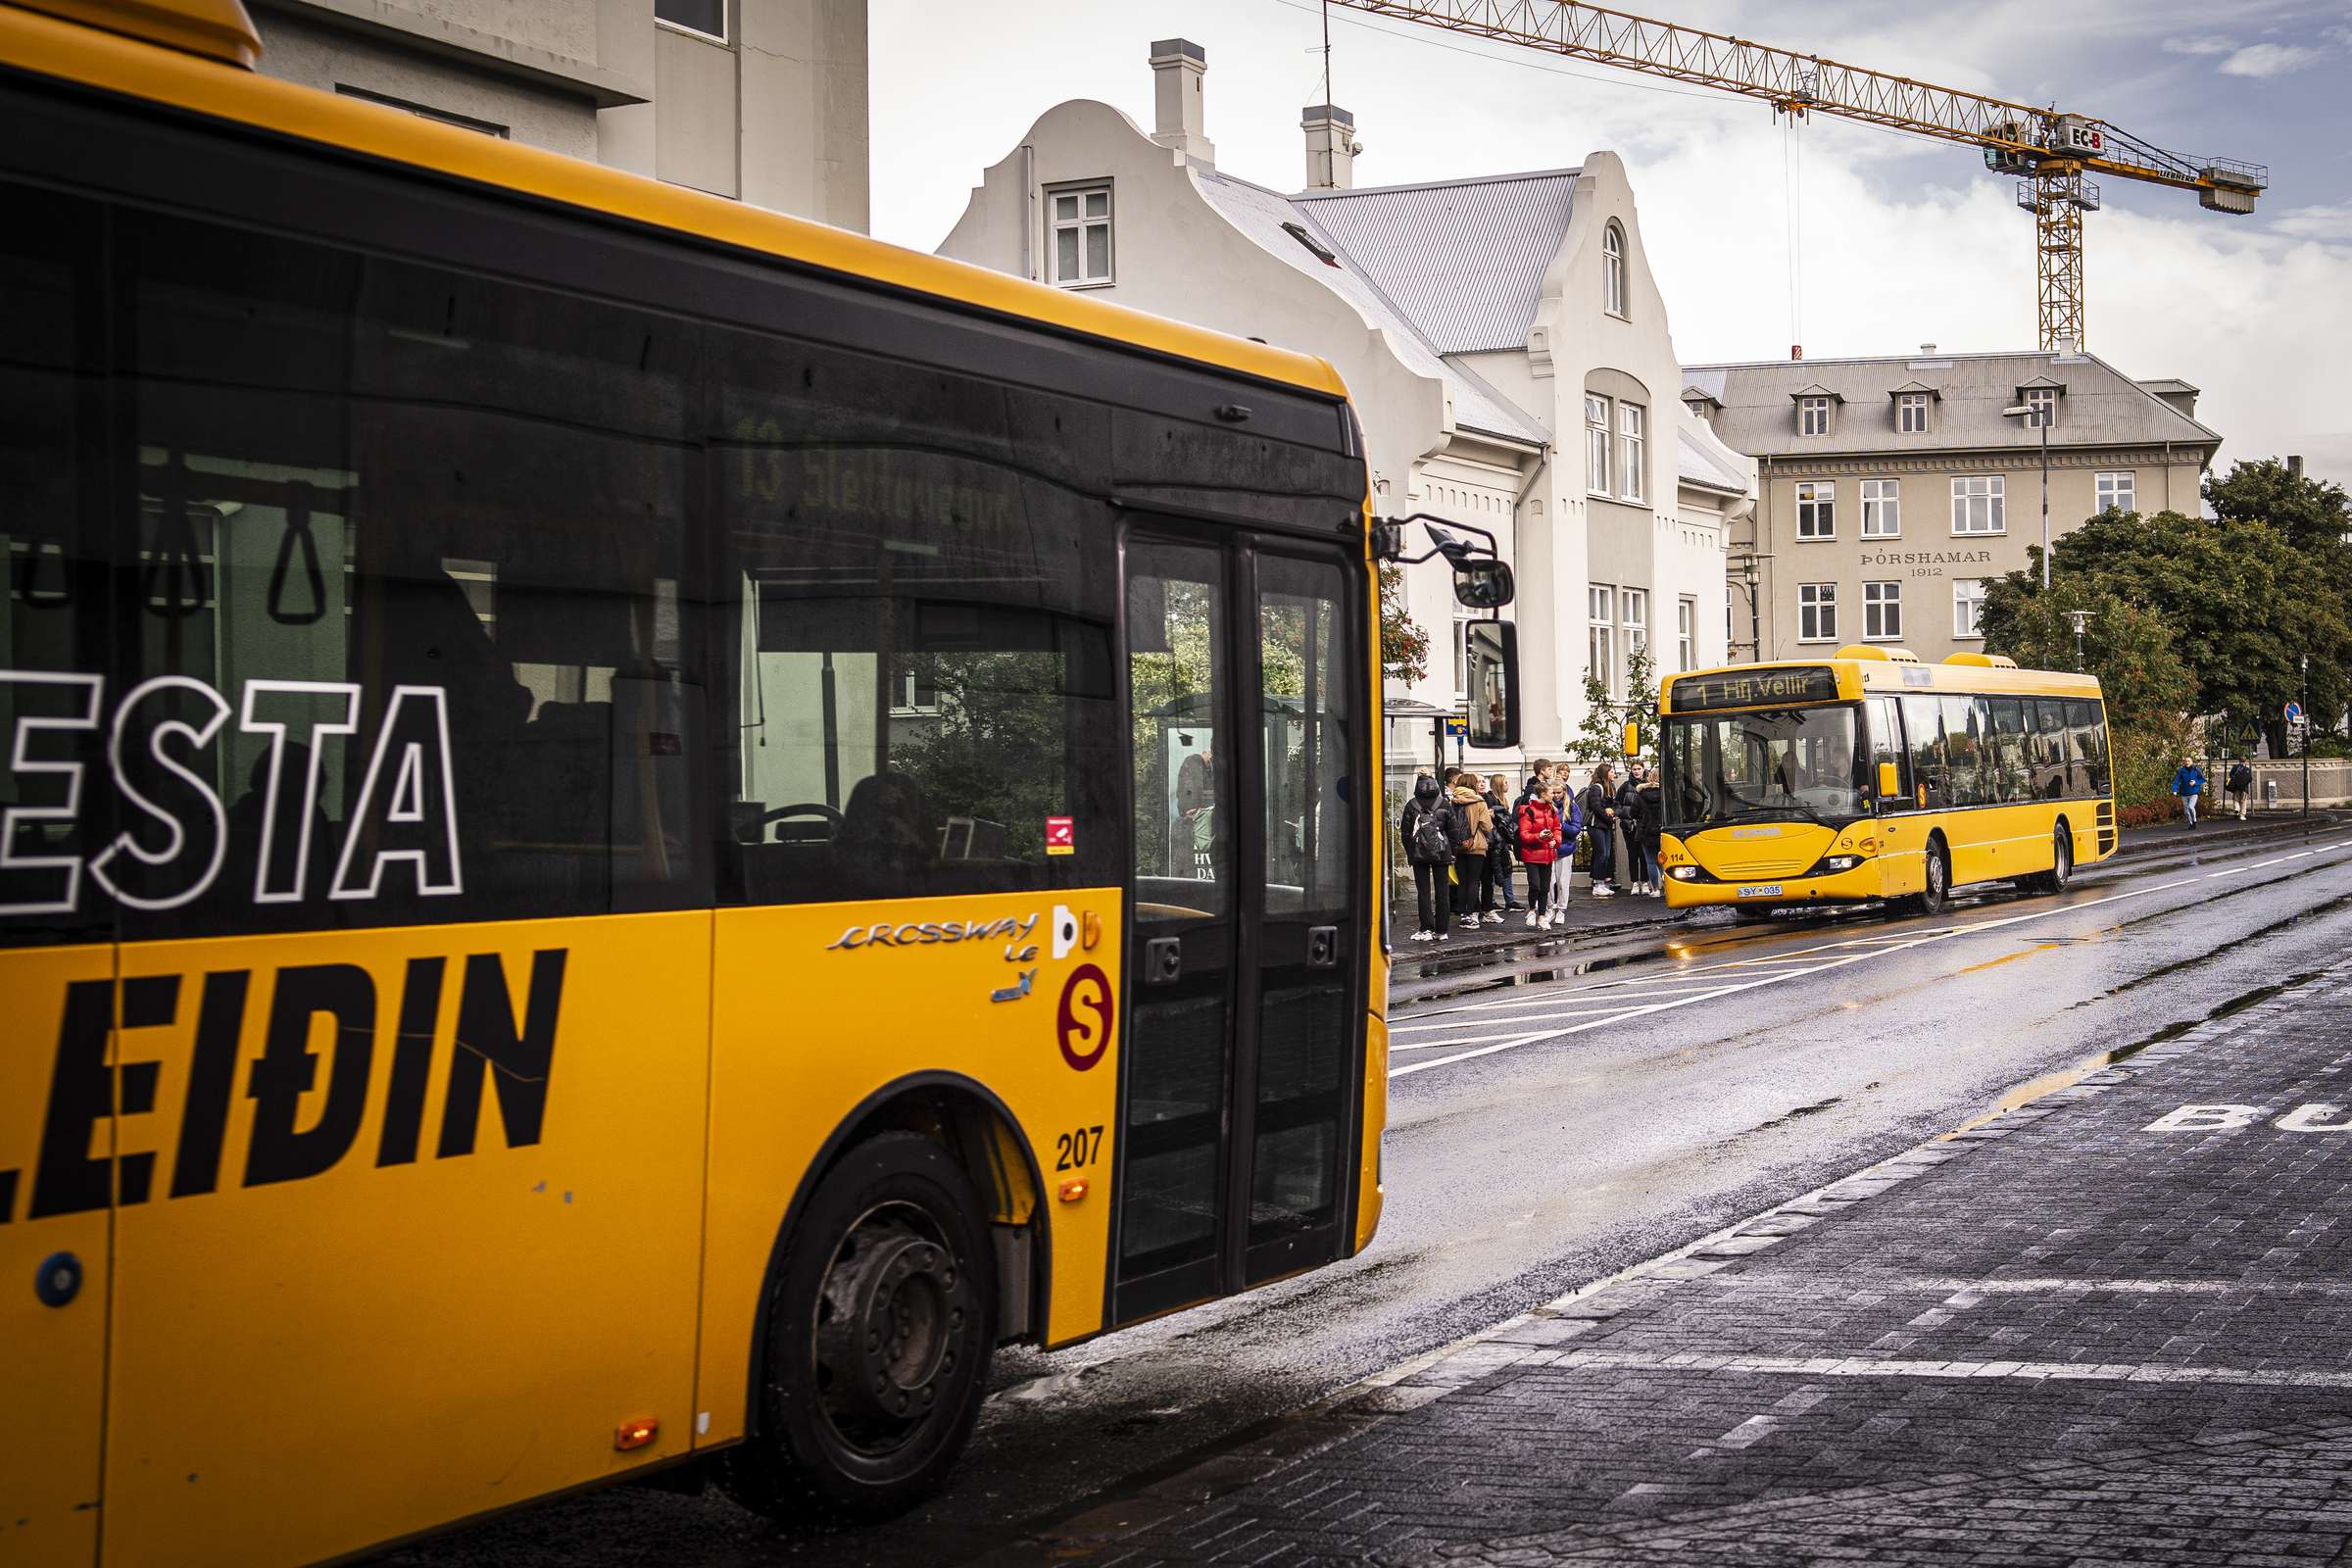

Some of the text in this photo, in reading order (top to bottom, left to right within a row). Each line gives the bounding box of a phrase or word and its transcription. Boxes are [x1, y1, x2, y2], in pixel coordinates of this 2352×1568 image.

[2072, 128, 2101, 149] EC-B
[2159, 170, 2197, 183] LIEBHERR
[1860, 548, 1991, 565] ÞÓRSHAMAR
[1911, 567, 1943, 577] 1912
[1697, 683, 1707, 706] 1
[1670, 854, 1684, 862] 114
[1743, 887, 1756, 896] SY
[825, 912, 1040, 951] CROSSWAY
[1004, 944, 1040, 962] LE
[0, 948, 568, 1224] EIÐIN
[1056, 1125, 1103, 1173] 207
